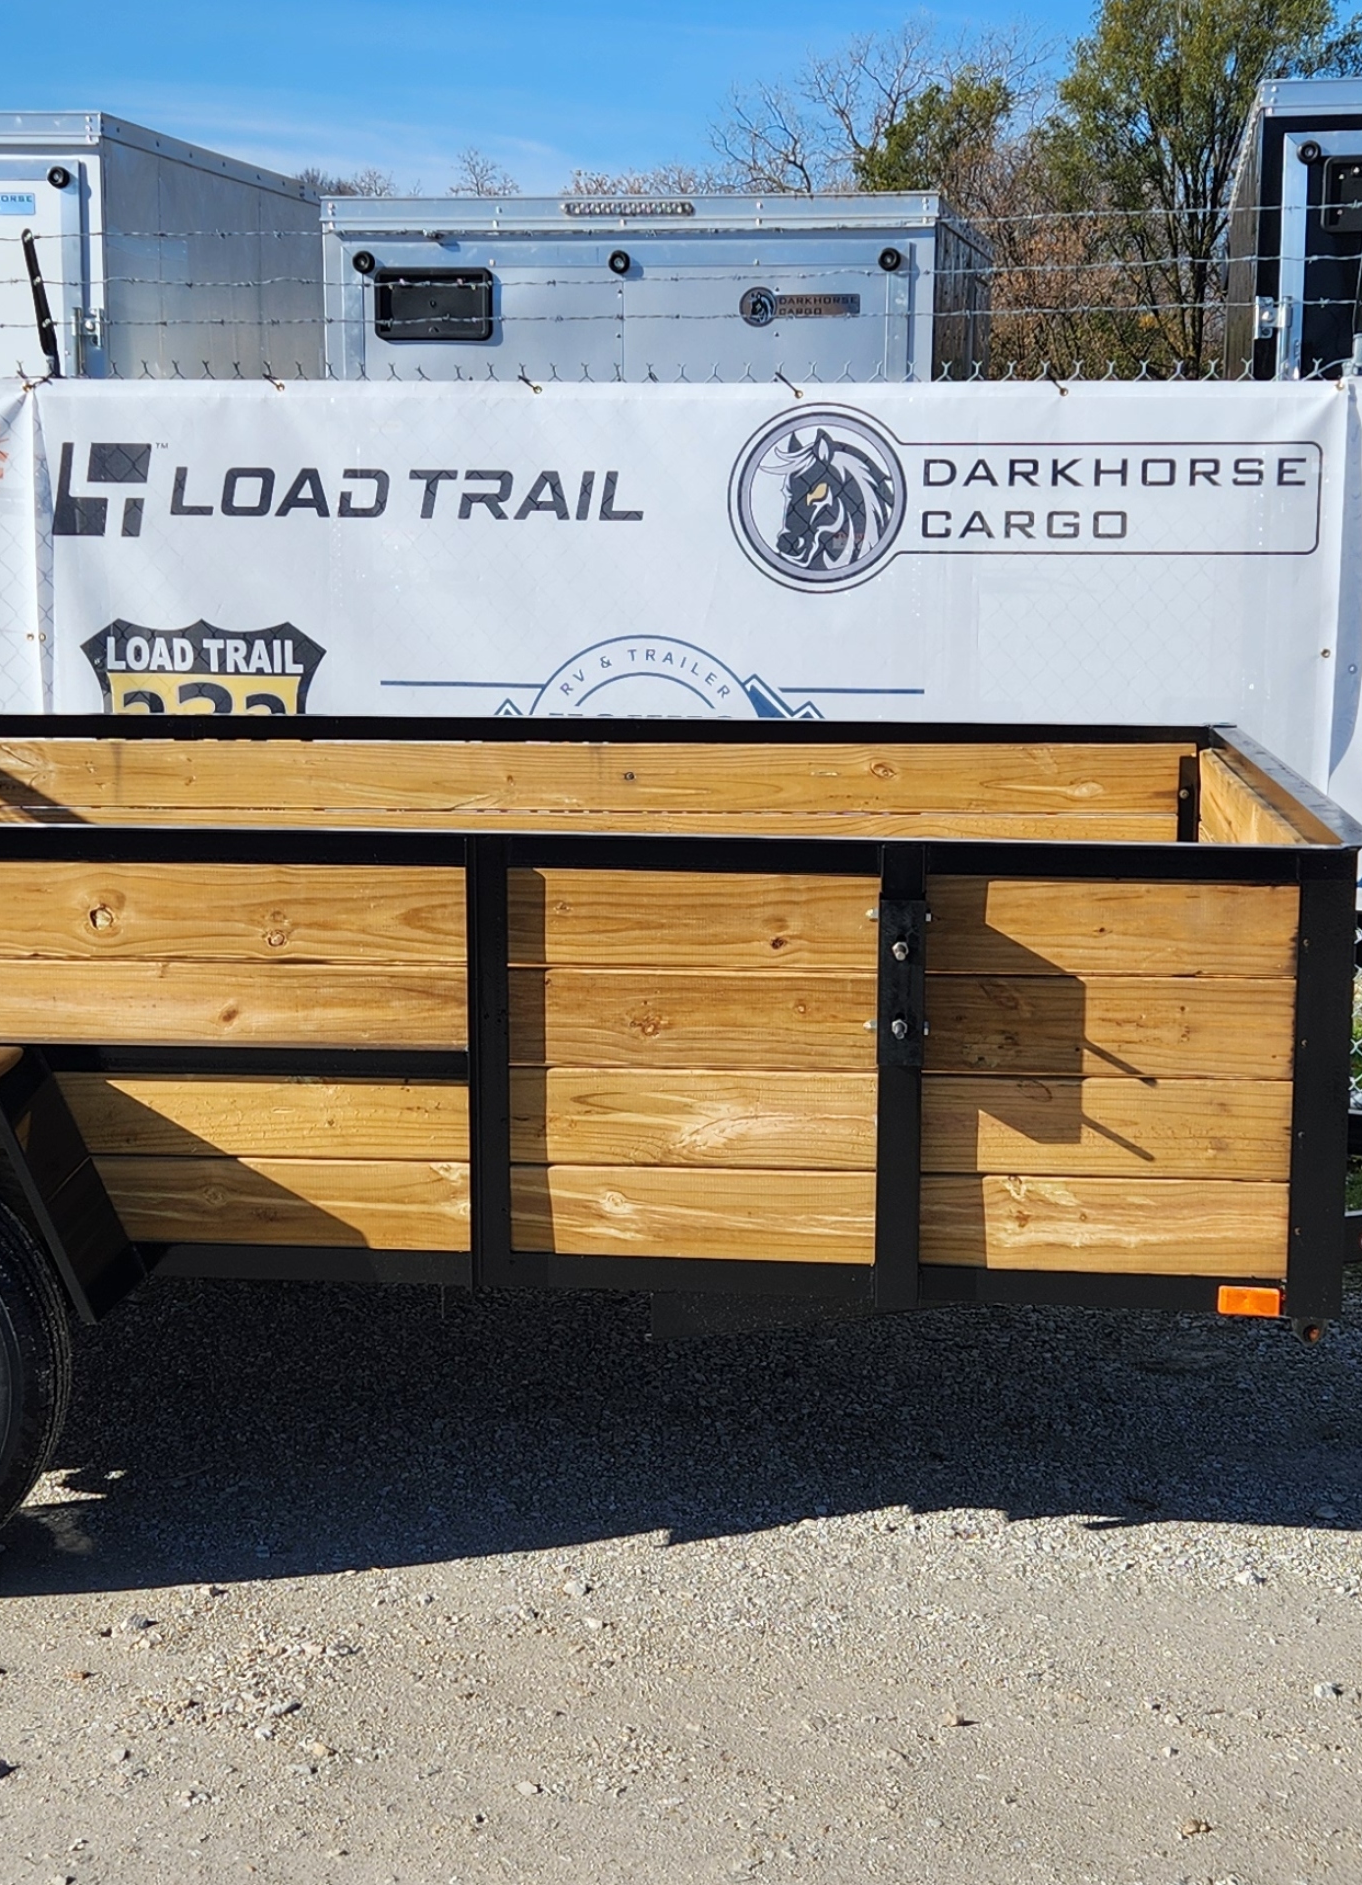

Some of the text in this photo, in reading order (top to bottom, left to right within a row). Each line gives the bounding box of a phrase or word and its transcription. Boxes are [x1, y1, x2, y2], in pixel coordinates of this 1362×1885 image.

[778, 297, 856, 305] DARKHORSE
[778, 308, 822, 316] CARGO
[923, 458, 1307, 487] DARKHORSE
[170, 467, 644, 521] LOAD TRAIL
[921, 510, 1127, 539] CARGO
[106, 636, 304, 674] LOAD TRAIL
[559, 648, 731, 698] RV & TRAILER
